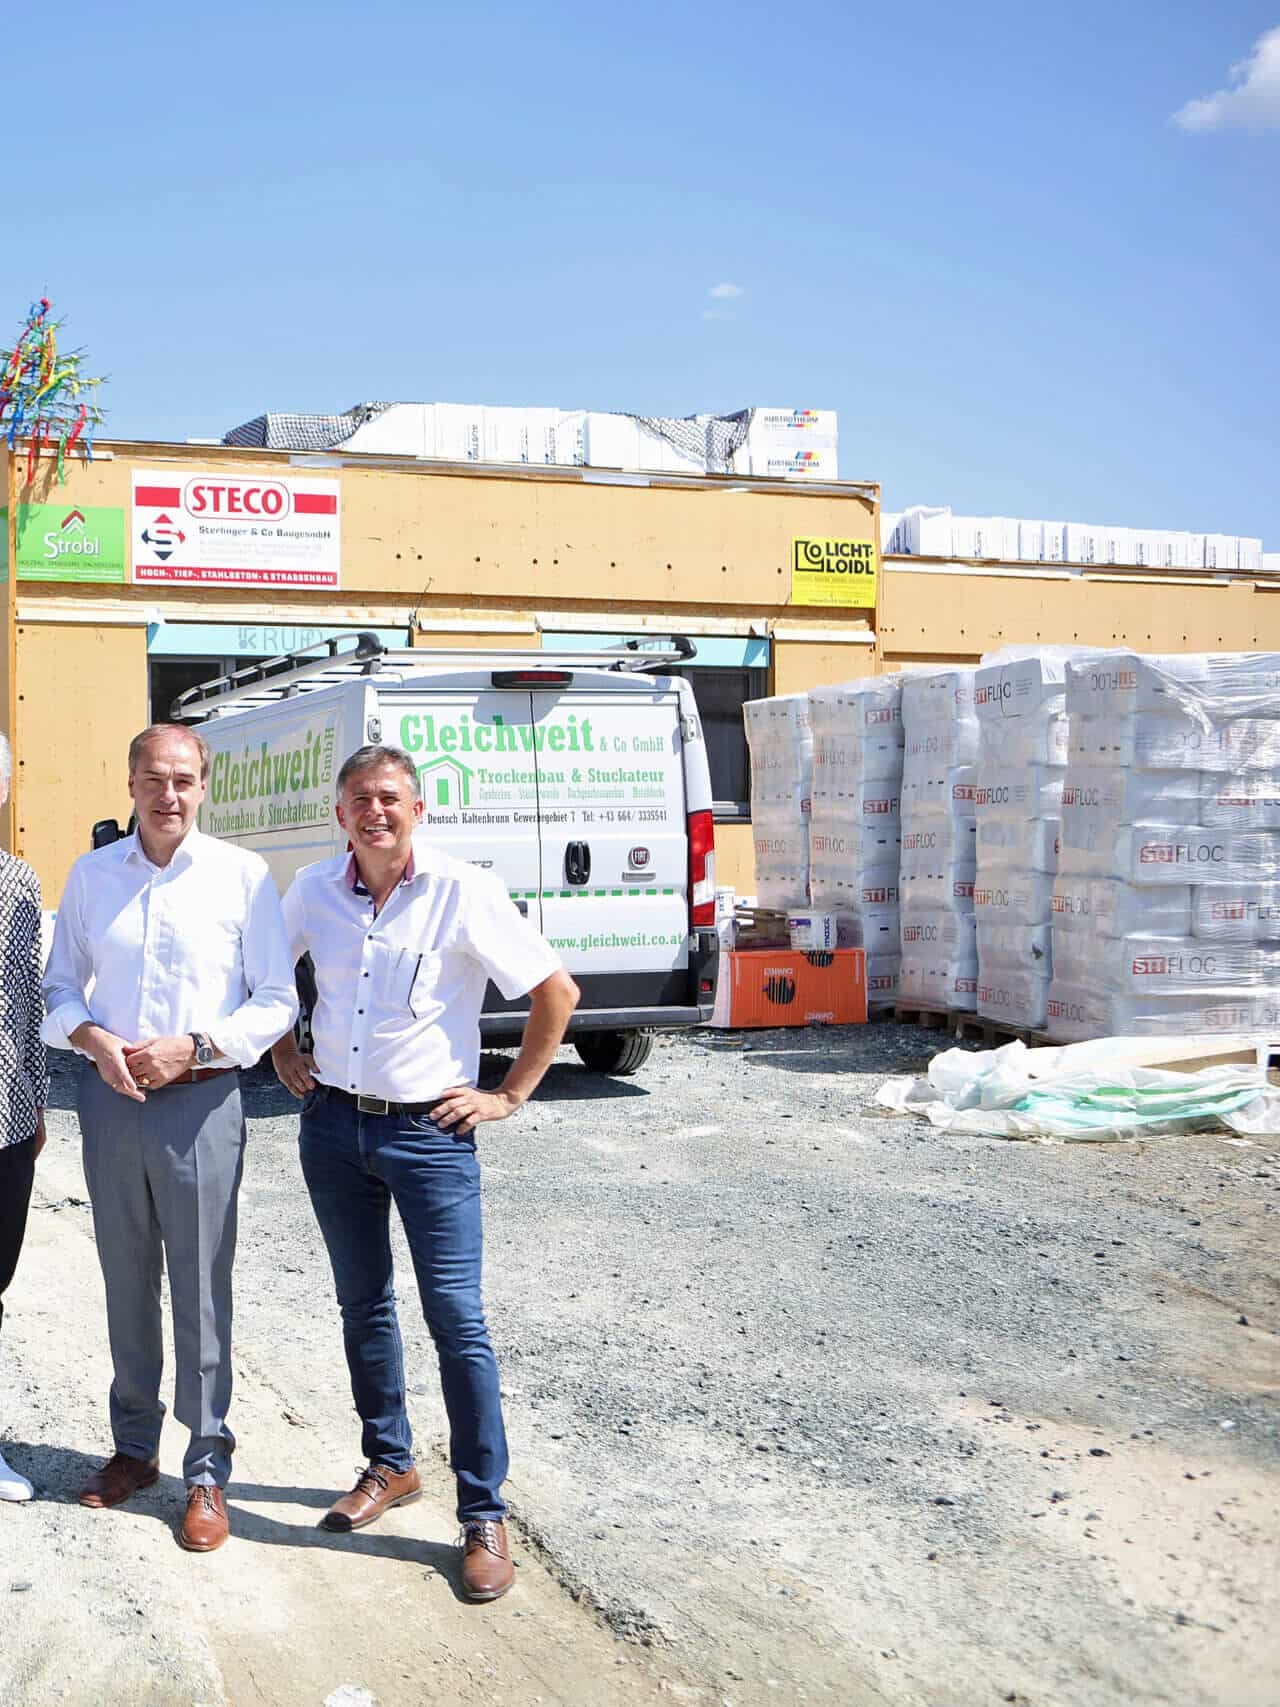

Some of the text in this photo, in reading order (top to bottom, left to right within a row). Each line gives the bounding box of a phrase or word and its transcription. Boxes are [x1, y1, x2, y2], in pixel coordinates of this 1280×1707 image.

[192, 485, 283, 515] STECO
[251, 527, 258, 536] &
[261, 528, 273, 537] Co
[43, 532, 100, 559] Strobl
[826, 559, 874, 575] LOIDL
[399, 714, 664, 752] Gleichweit & Co GmbH
[211, 730, 322, 805] Gleichweit
[478, 767, 665, 784] Trockenbau & Stuckateur
[209, 800, 318, 832] Trockenbau & Stuckateur
[428, 812, 458, 825] Deutsch
[462, 812, 510, 824] Kaltenbrunn
[513, 811, 568, 825] Gewerbegebiet
[634, 850, 648, 864] FIAT
[546, 932, 684, 951] www.gleichweit.co.at
